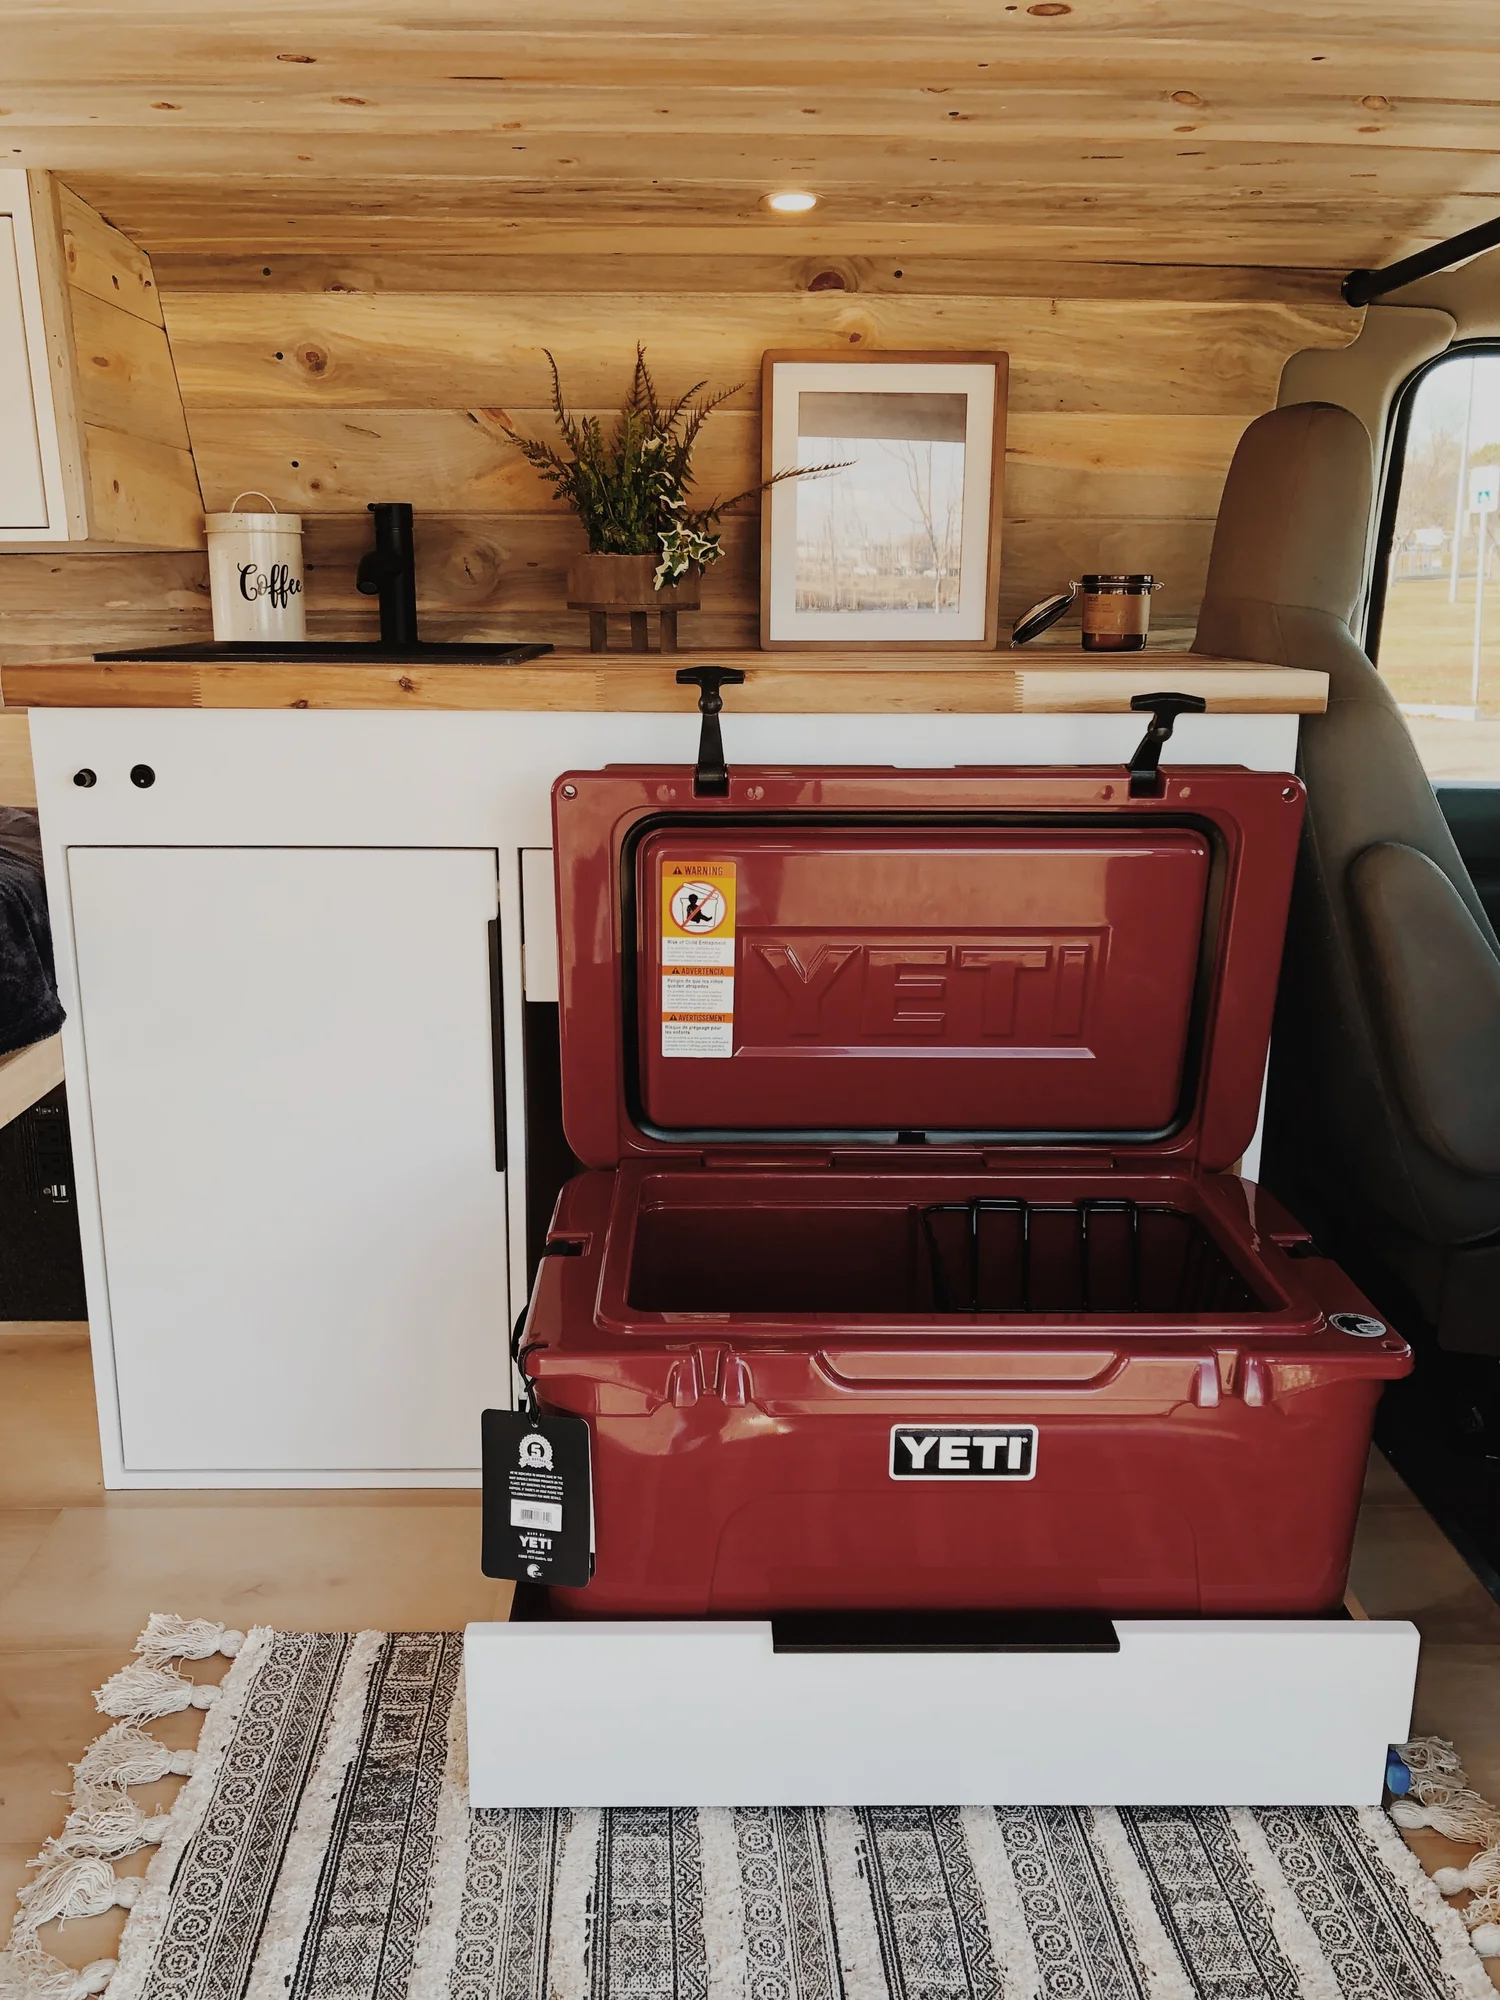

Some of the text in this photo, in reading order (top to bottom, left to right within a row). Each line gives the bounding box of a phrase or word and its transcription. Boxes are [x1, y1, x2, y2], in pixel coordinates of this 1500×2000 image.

[237, 563, 302, 609] Coffee
[684, 866, 723, 876] WARNING
[681, 967, 725, 976] ADVERTENCIA
[752, 943, 1092, 1038] YETI
[531, 1443, 541, 1457] 5
[899, 1436, 1023, 1470] YETI
[519, 1535, 552, 1550] YETI
